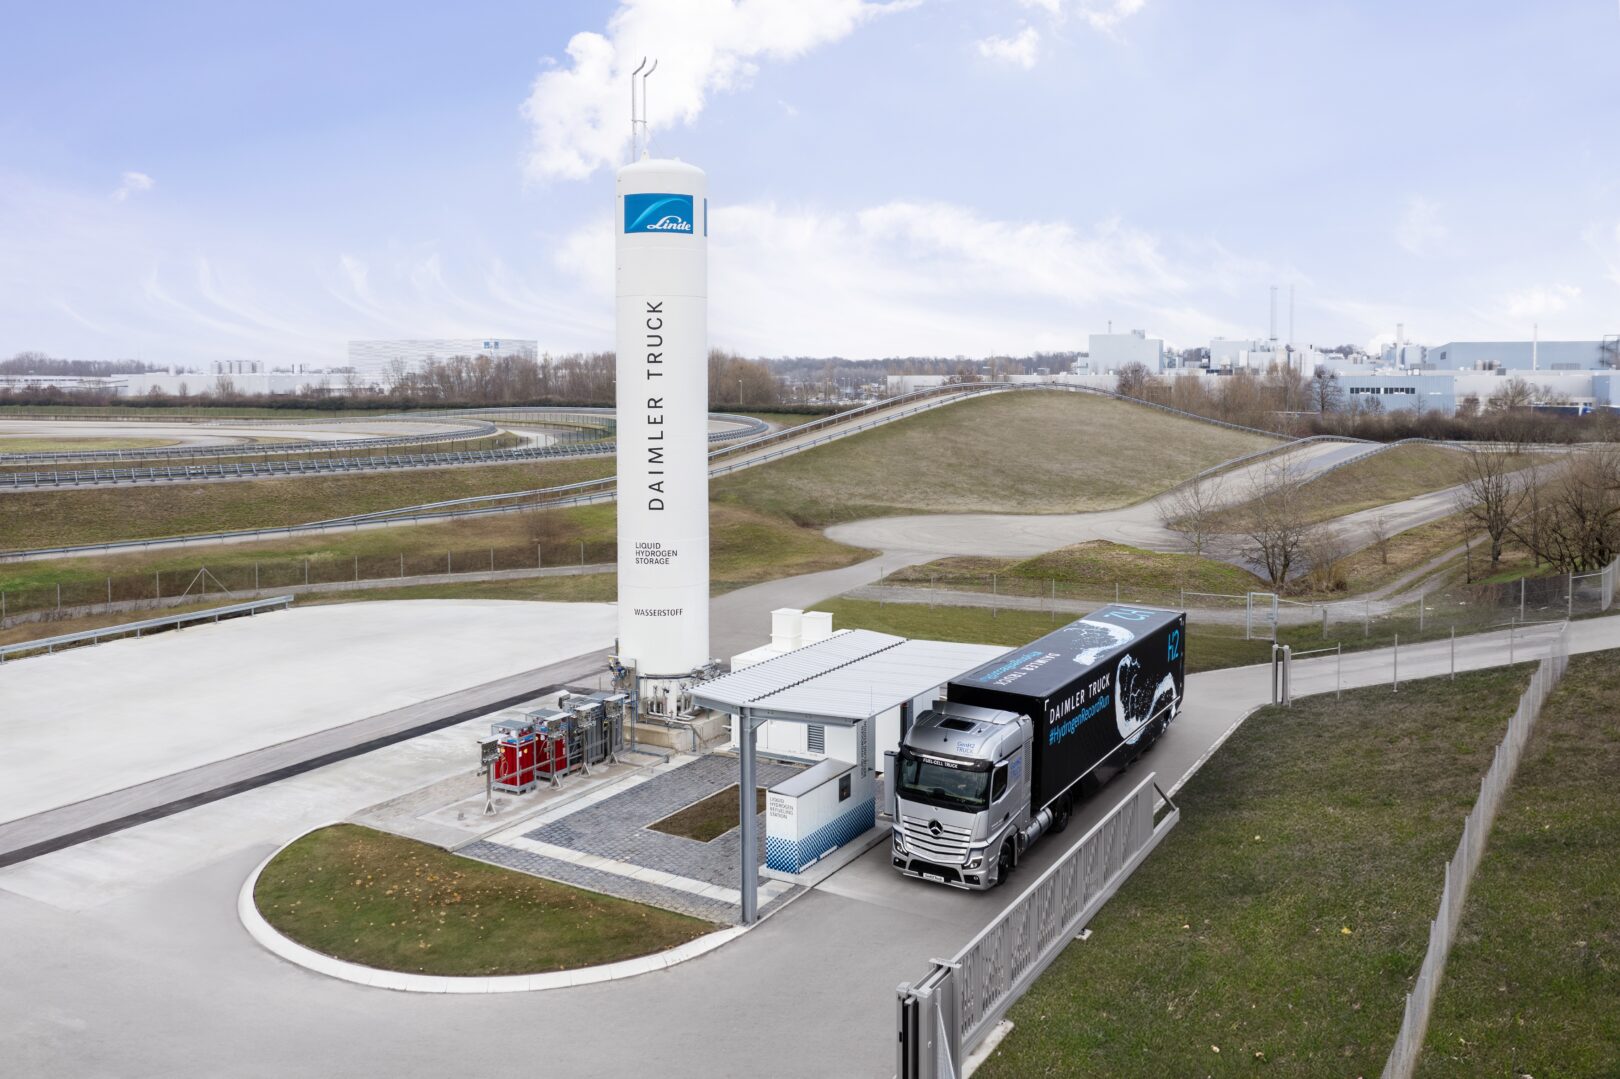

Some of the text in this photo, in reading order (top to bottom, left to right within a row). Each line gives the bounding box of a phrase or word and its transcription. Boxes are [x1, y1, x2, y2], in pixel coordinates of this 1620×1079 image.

[646, 215, 691, 231] Linde
[646, 301, 664, 511] DAIMLER TRUCK
[635, 542, 661, 550] LIQUID
[635, 549, 678, 557] HYDROGEN
[635, 557, 670, 565] STORAGE
[633, 608, 683, 617] WASSERSTOFF
[1049, 672, 1111, 725] DAIMLER TRUCK
[1048, 694, 1110, 746] #HydrogenRecordRun
[956, 746, 974, 754] TRUCK
